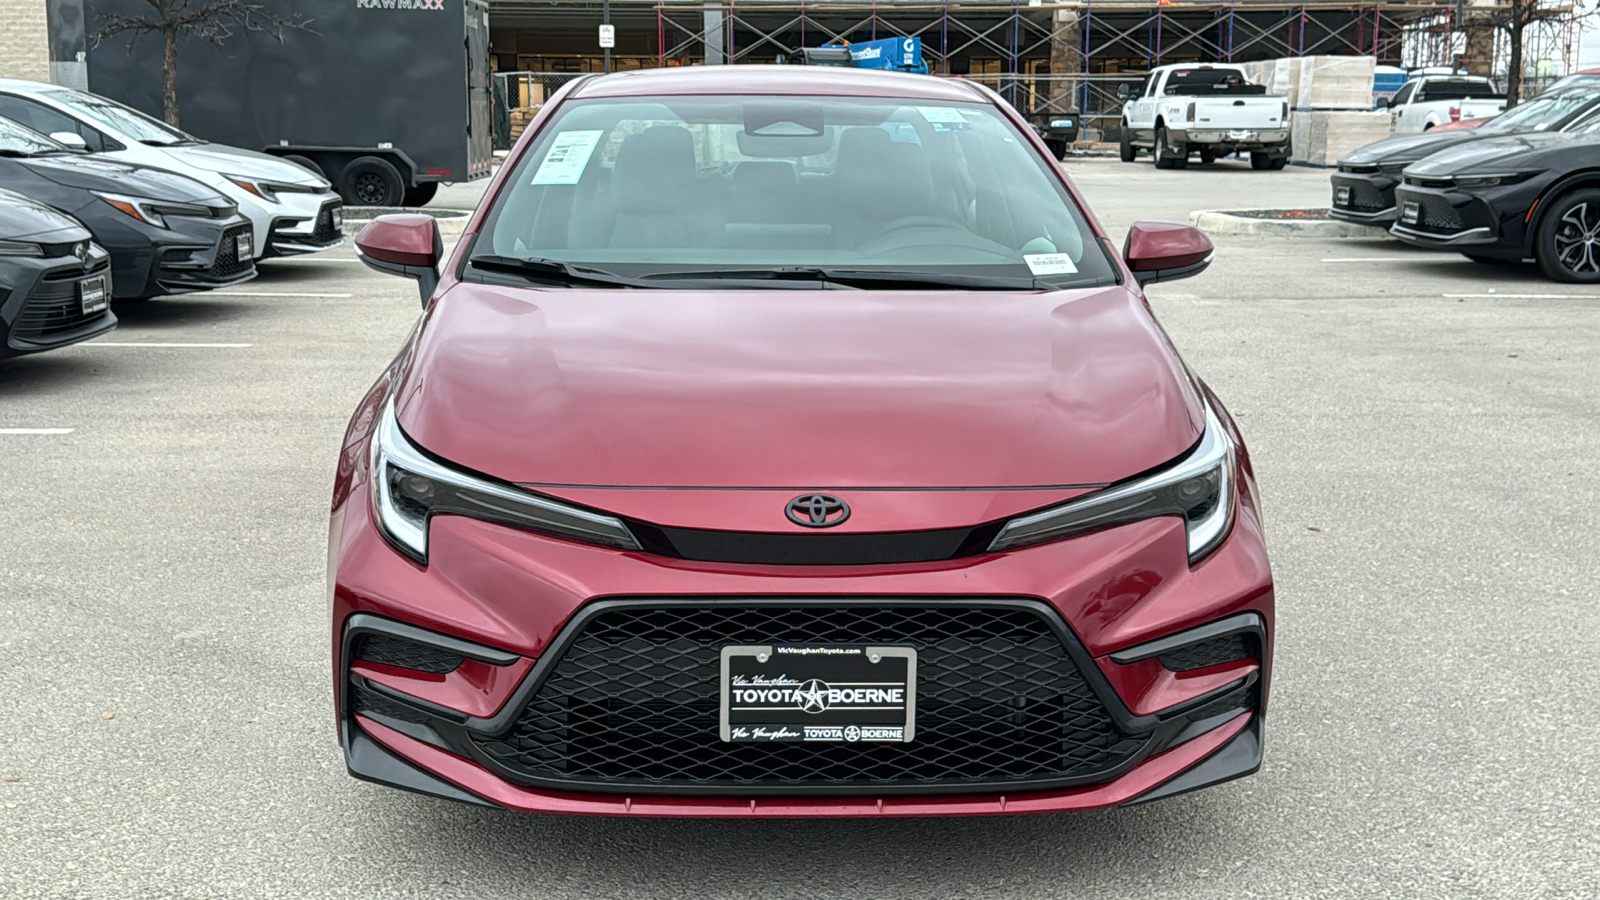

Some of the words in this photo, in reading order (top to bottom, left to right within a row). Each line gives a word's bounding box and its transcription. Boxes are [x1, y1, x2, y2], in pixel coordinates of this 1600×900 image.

[356, 0, 444, 10] RAWMAXX
[731, 675, 748, 685] Vic
[732, 689, 803, 703] TOYOTA
[828, 689, 904, 703] BOERNE
[804, 729, 843, 738] TOYOTA
[861, 729, 903, 738] BOERNE
